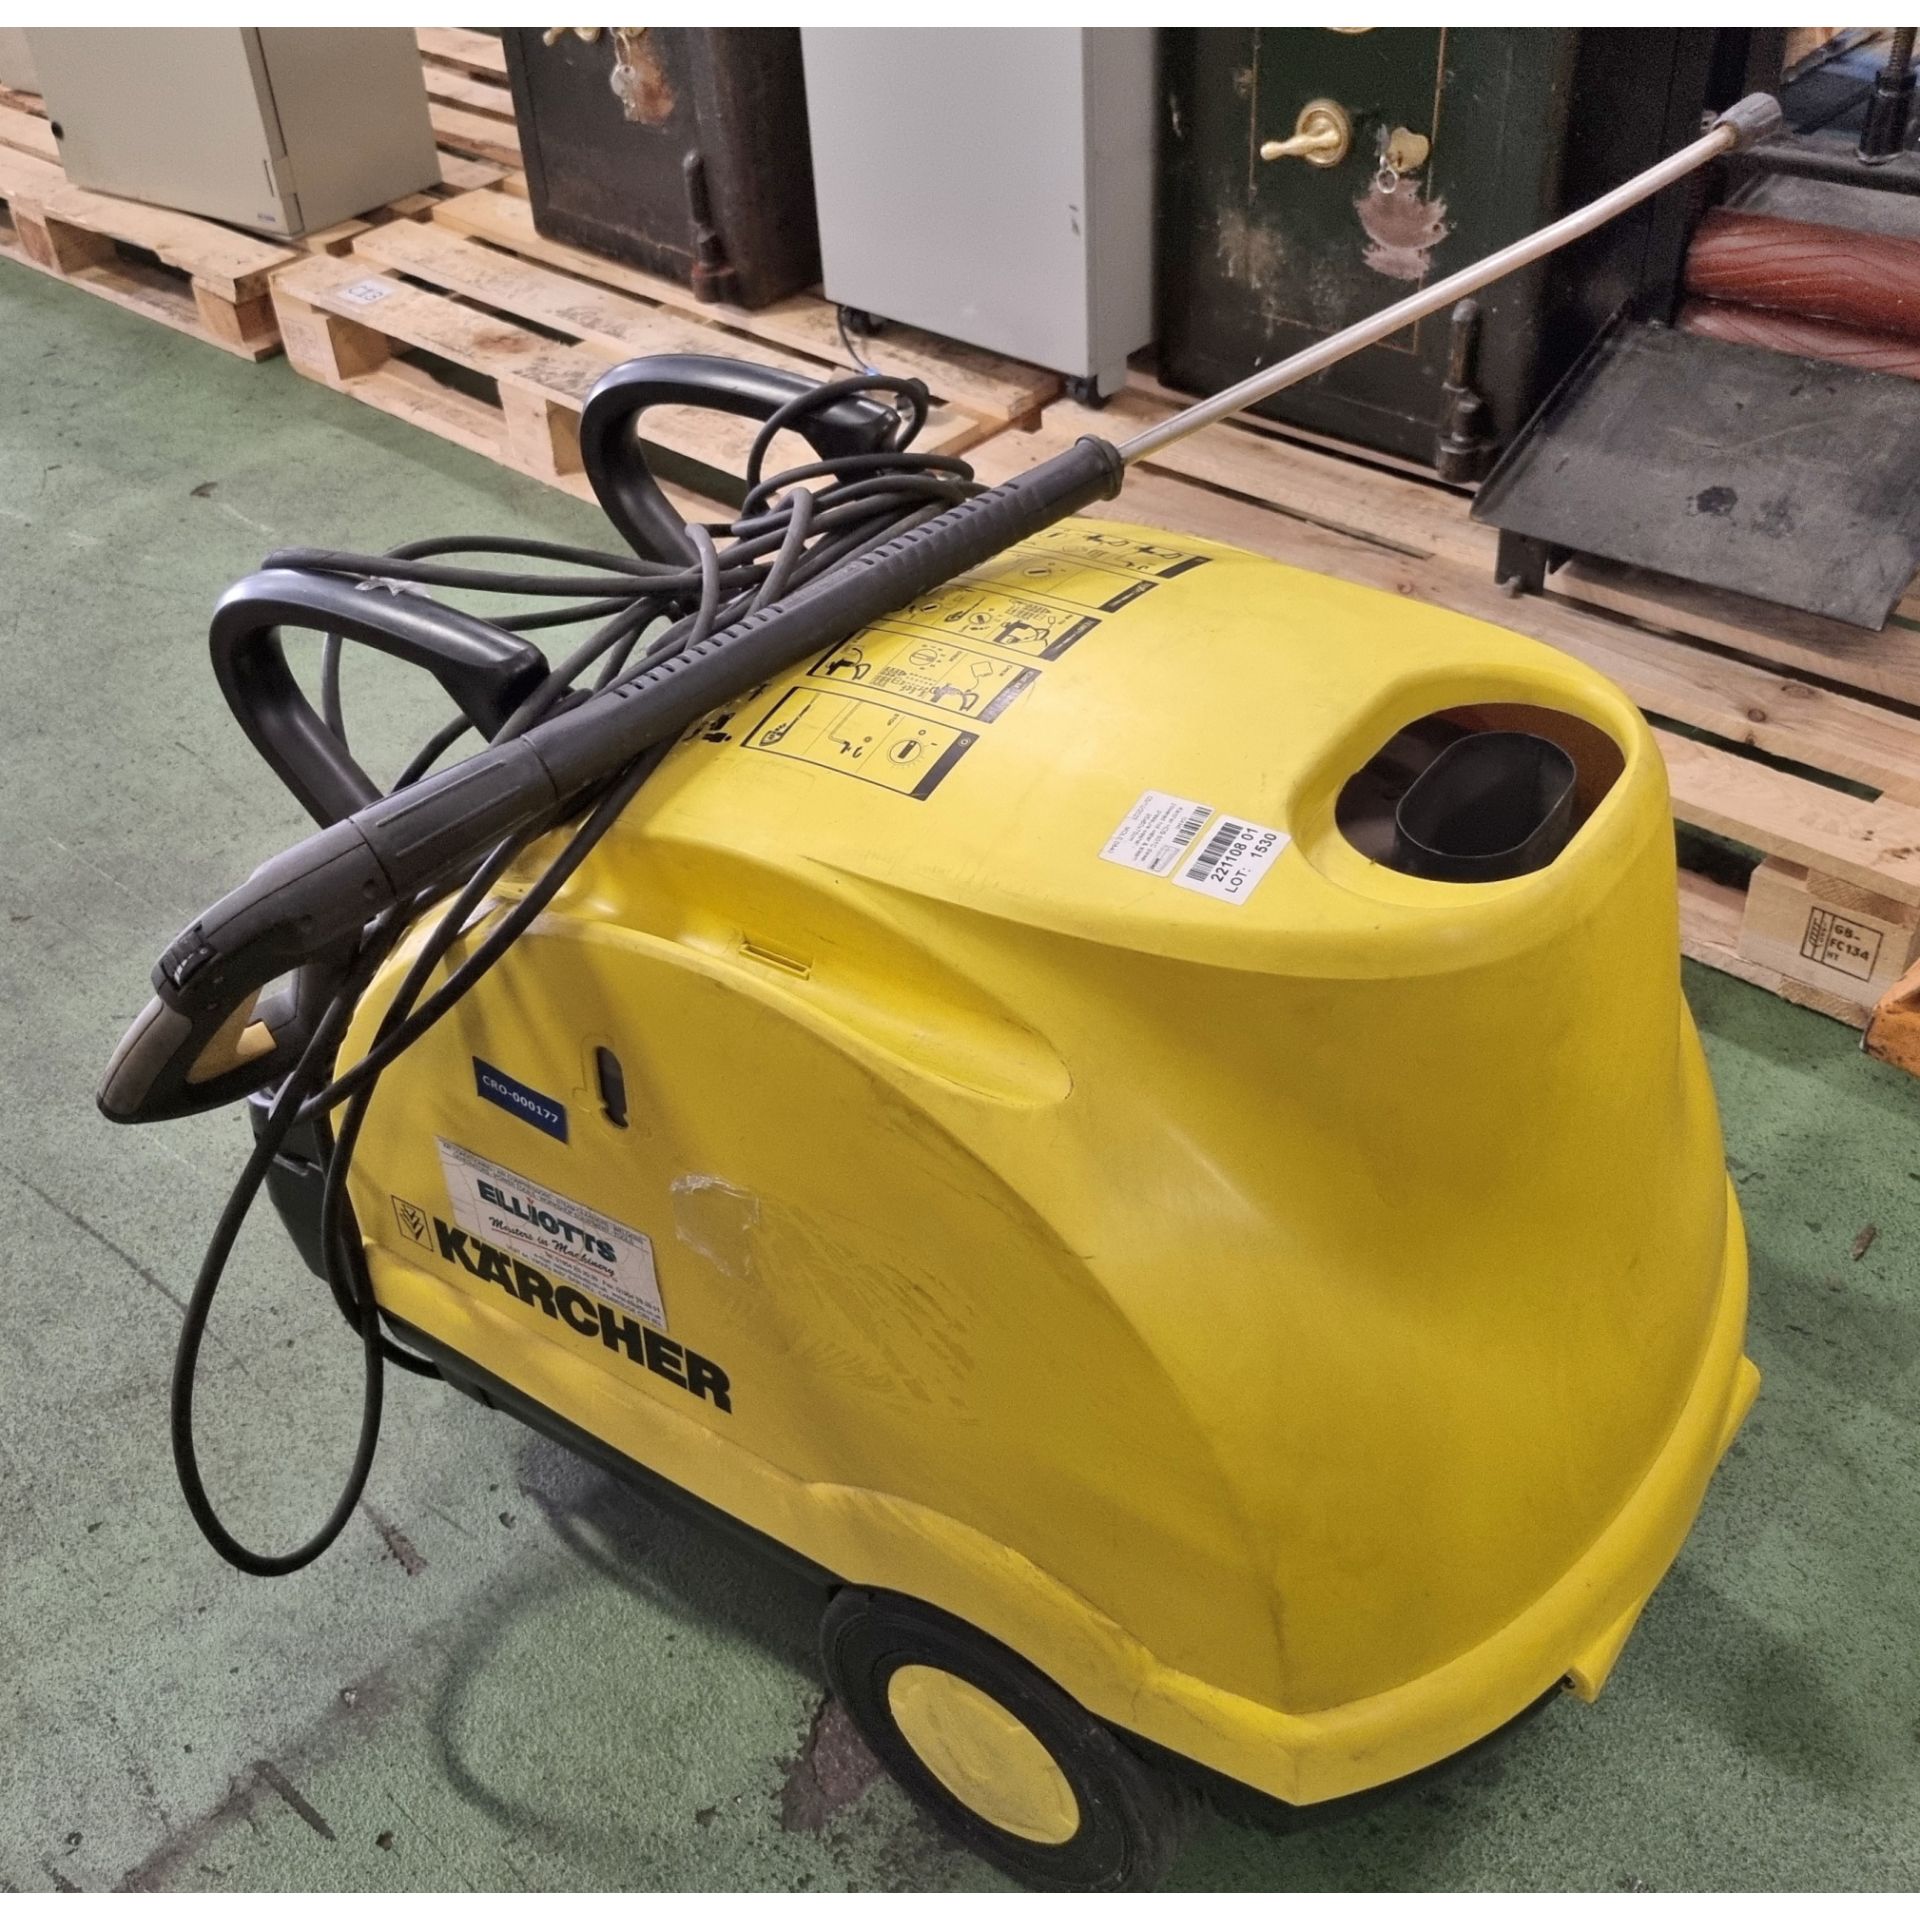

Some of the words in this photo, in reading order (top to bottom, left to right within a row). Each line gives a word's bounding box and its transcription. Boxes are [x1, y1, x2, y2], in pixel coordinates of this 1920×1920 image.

[1211, 843, 1247, 882] 221108
[1240, 828, 1258, 841] 01
[1225, 867, 1251, 893] LOT:
[1250, 833, 1277, 858] 1530
[482, 1075, 559, 1123] CRO-000177
[433, 1216, 732, 1414] KÄRCHER
